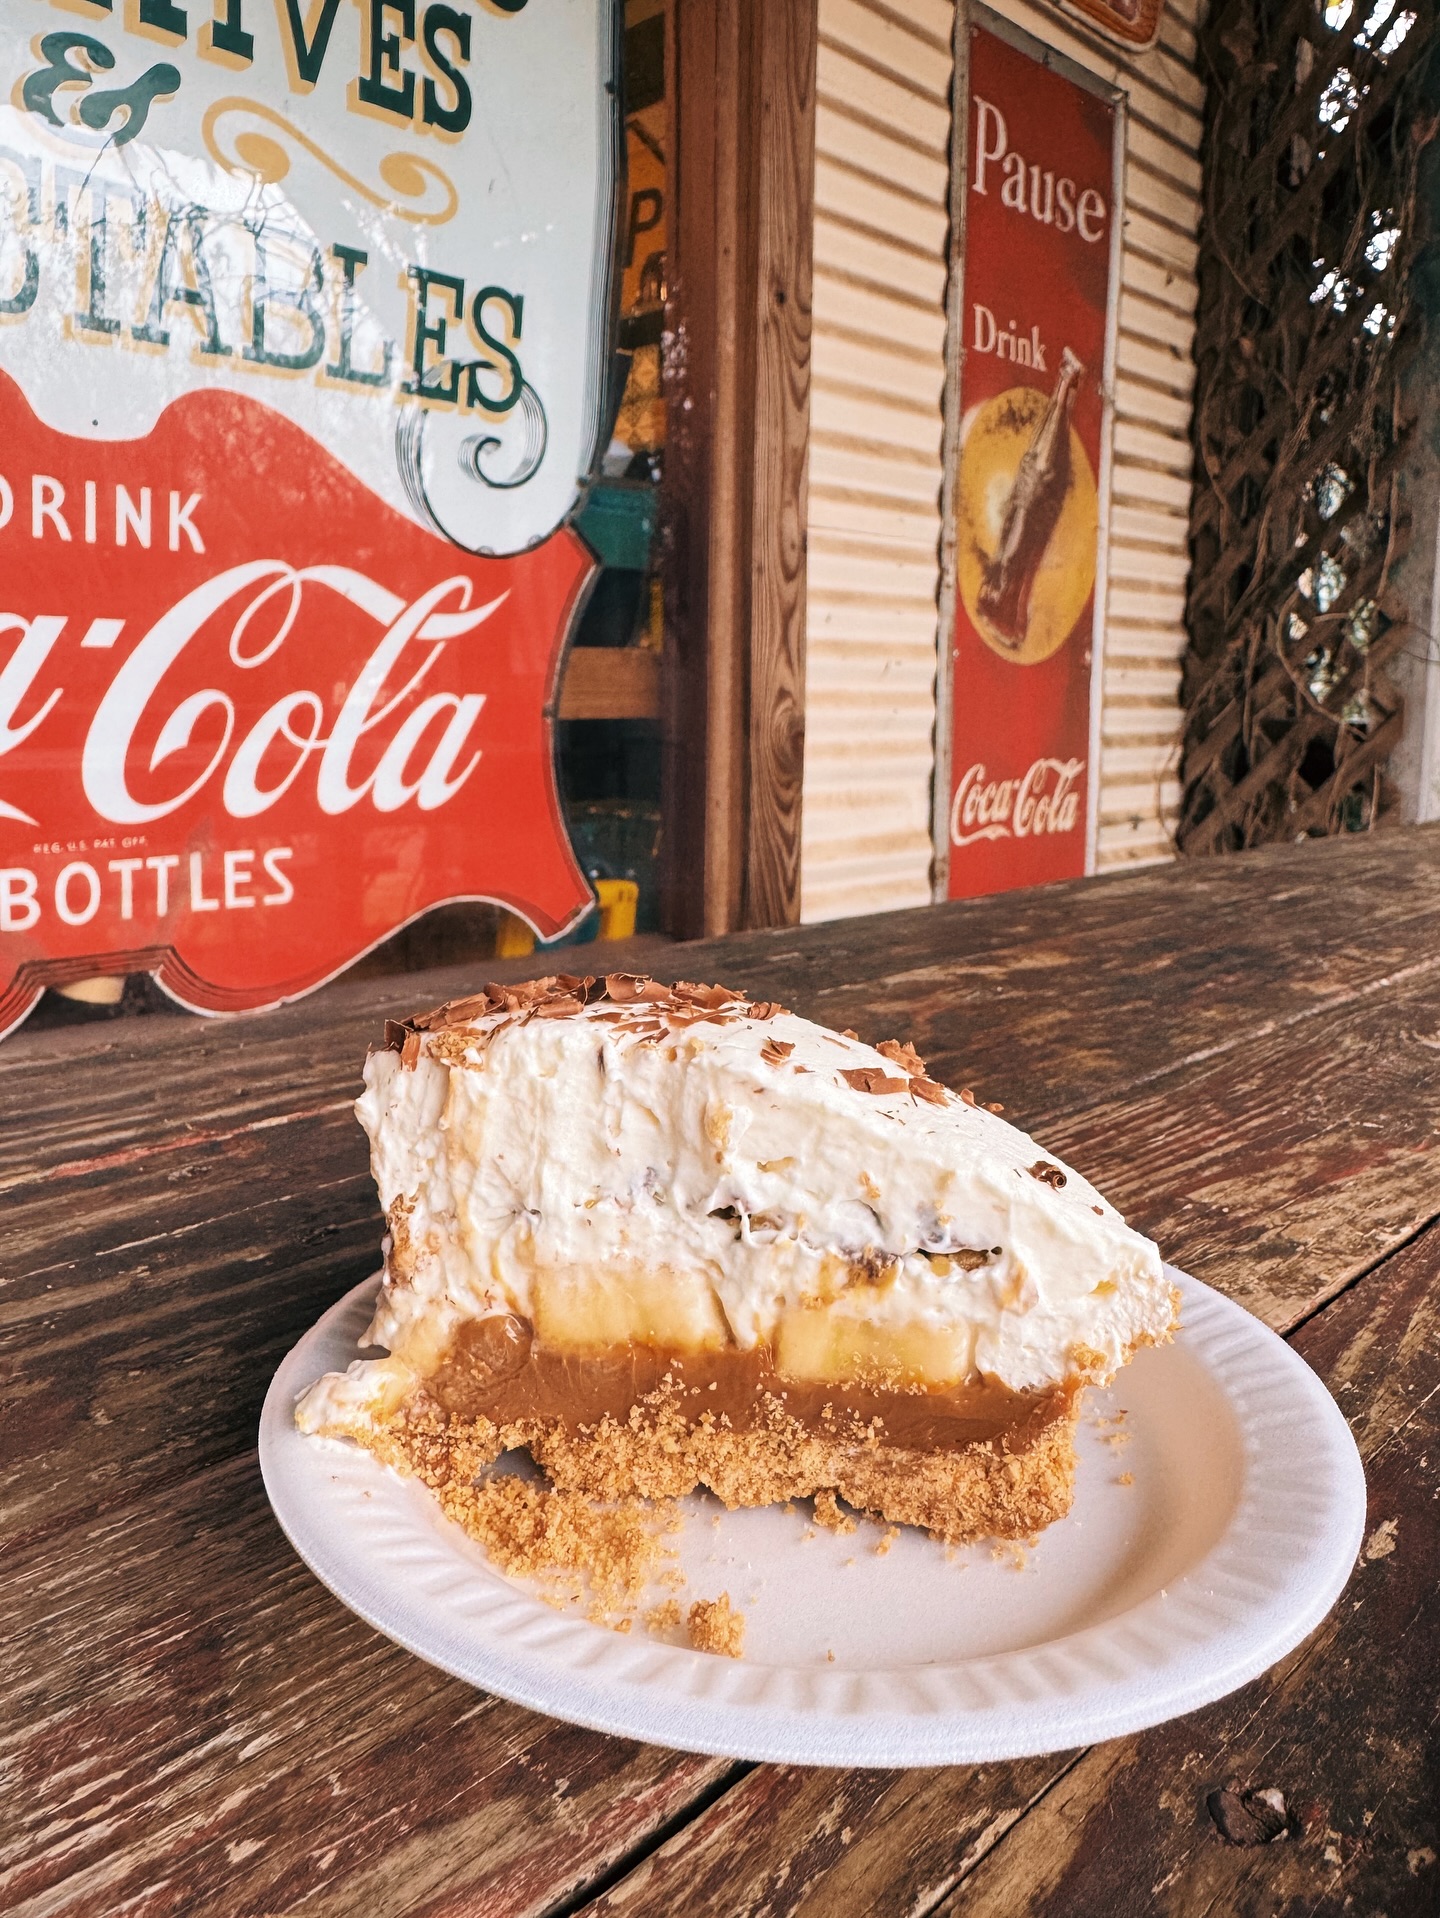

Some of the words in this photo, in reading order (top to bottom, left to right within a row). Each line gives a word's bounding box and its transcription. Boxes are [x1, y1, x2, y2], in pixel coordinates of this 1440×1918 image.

[972, 94, 1108, 243] Pause
[971, 303, 1047, 372] Drink
[0, 847, 294, 932] BOTTLES
